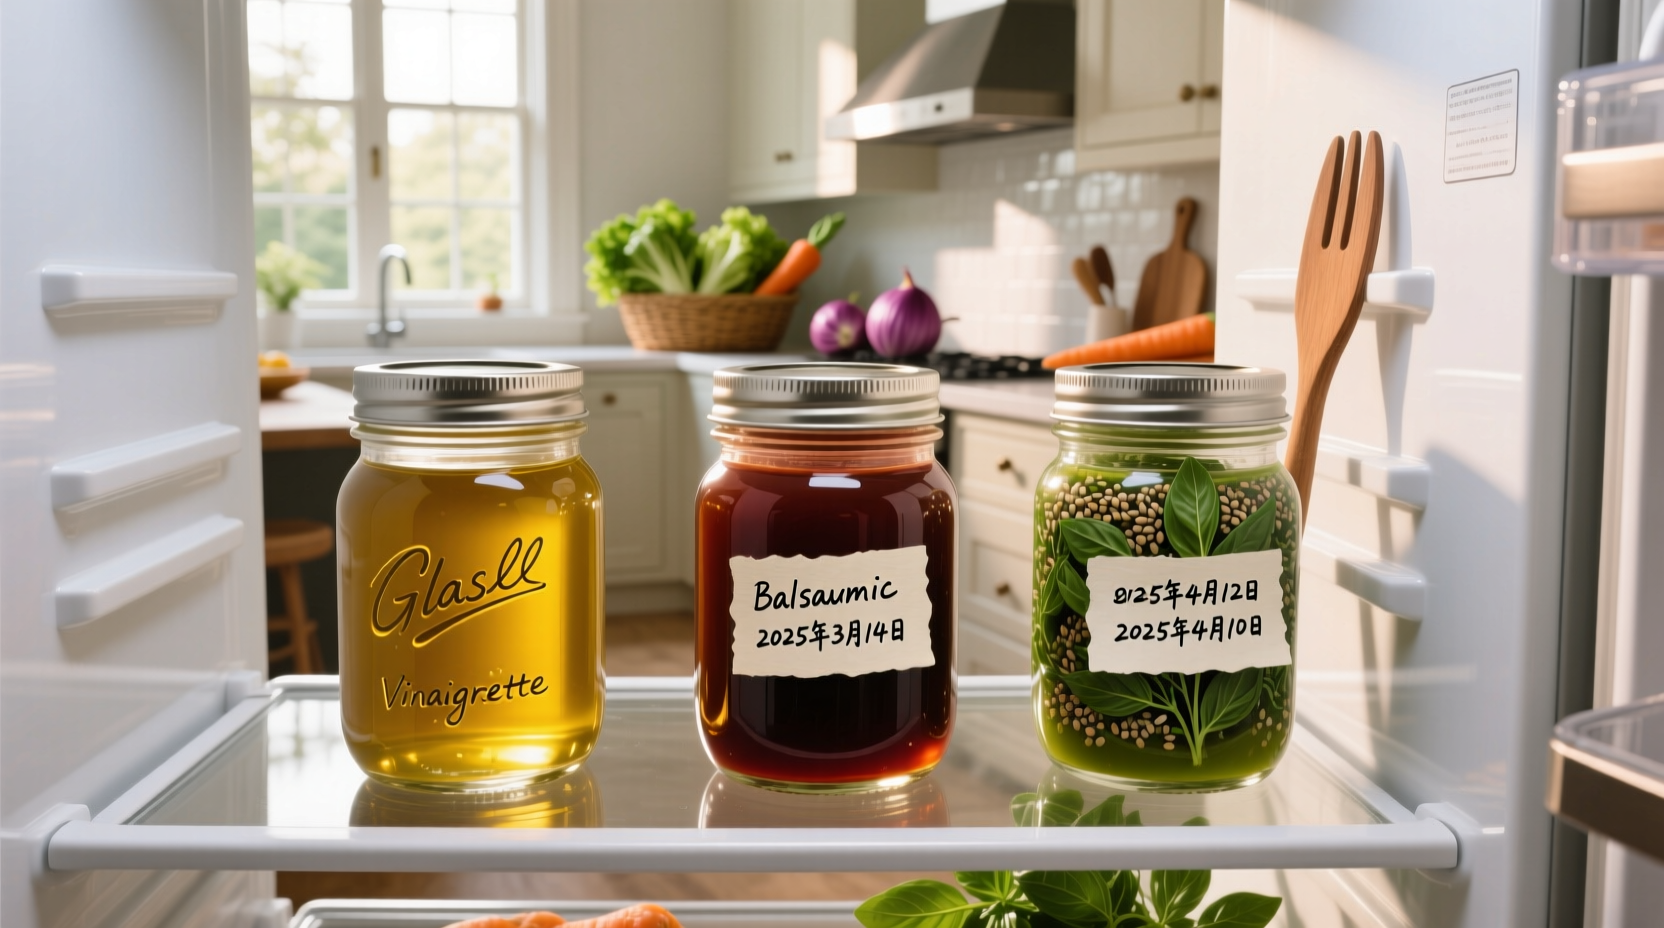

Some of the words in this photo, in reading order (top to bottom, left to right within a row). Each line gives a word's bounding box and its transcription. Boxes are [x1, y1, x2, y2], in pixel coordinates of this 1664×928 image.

[753, 576, 899, 612] Balsaumic
[756, 618, 905, 652] 2025年3月14日
[1114, 615, 1262, 648] 2025年4月10日
[382, 673, 549, 727] Vinaigrette
